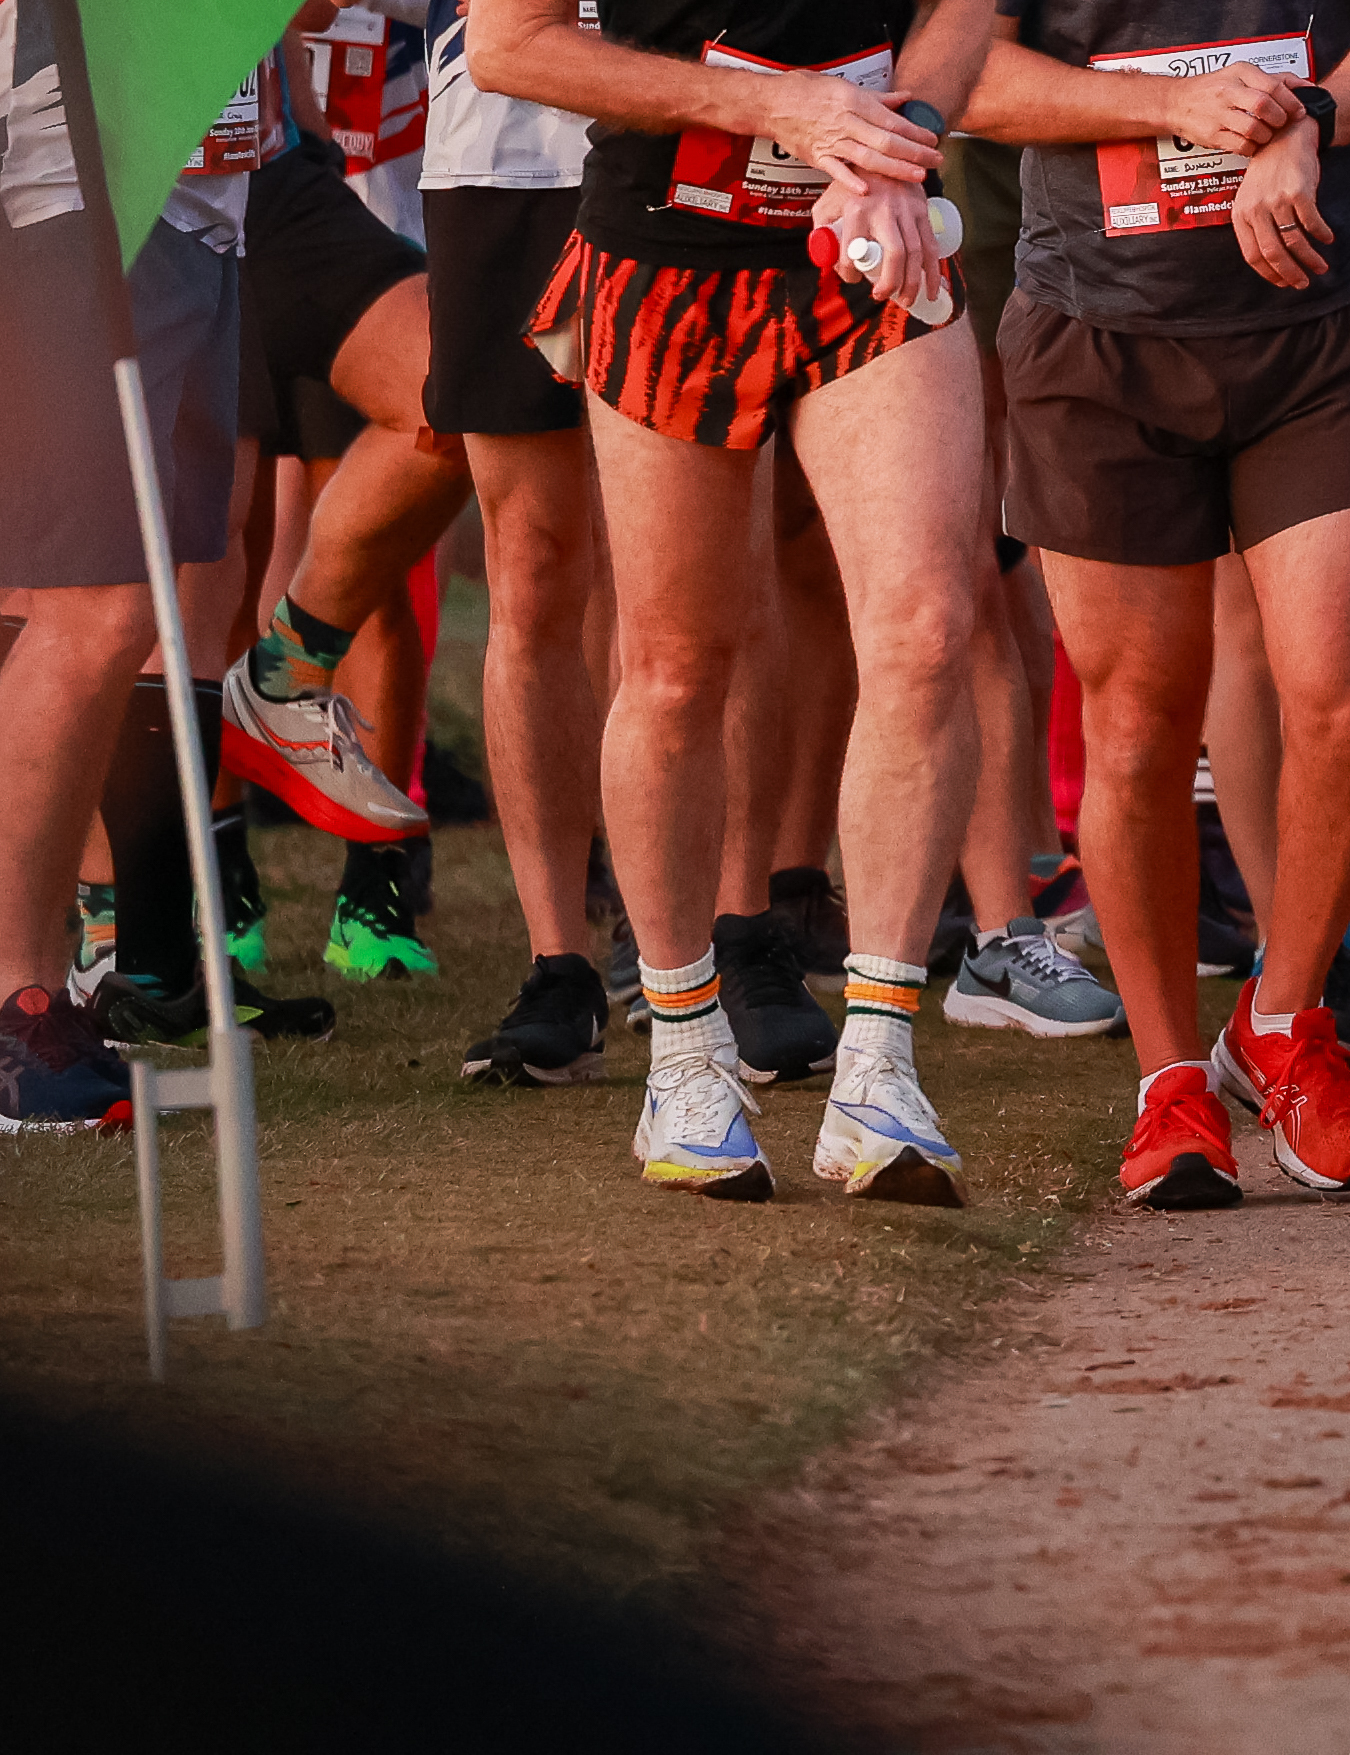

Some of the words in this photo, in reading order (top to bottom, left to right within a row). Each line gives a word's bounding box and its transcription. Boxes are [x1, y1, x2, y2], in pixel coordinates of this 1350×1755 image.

[577, 21, 601, 30] Sund
[1248, 52, 1300, 64] CORNERSTONE
[741, 180, 779, 194] Sunday
[1160, 180, 1196, 193] Sunday
[1197, 176, 1220, 188] 18th
[1220, 175, 1244, 185] June
[1183, 199, 1234, 215] #IamRedcl
